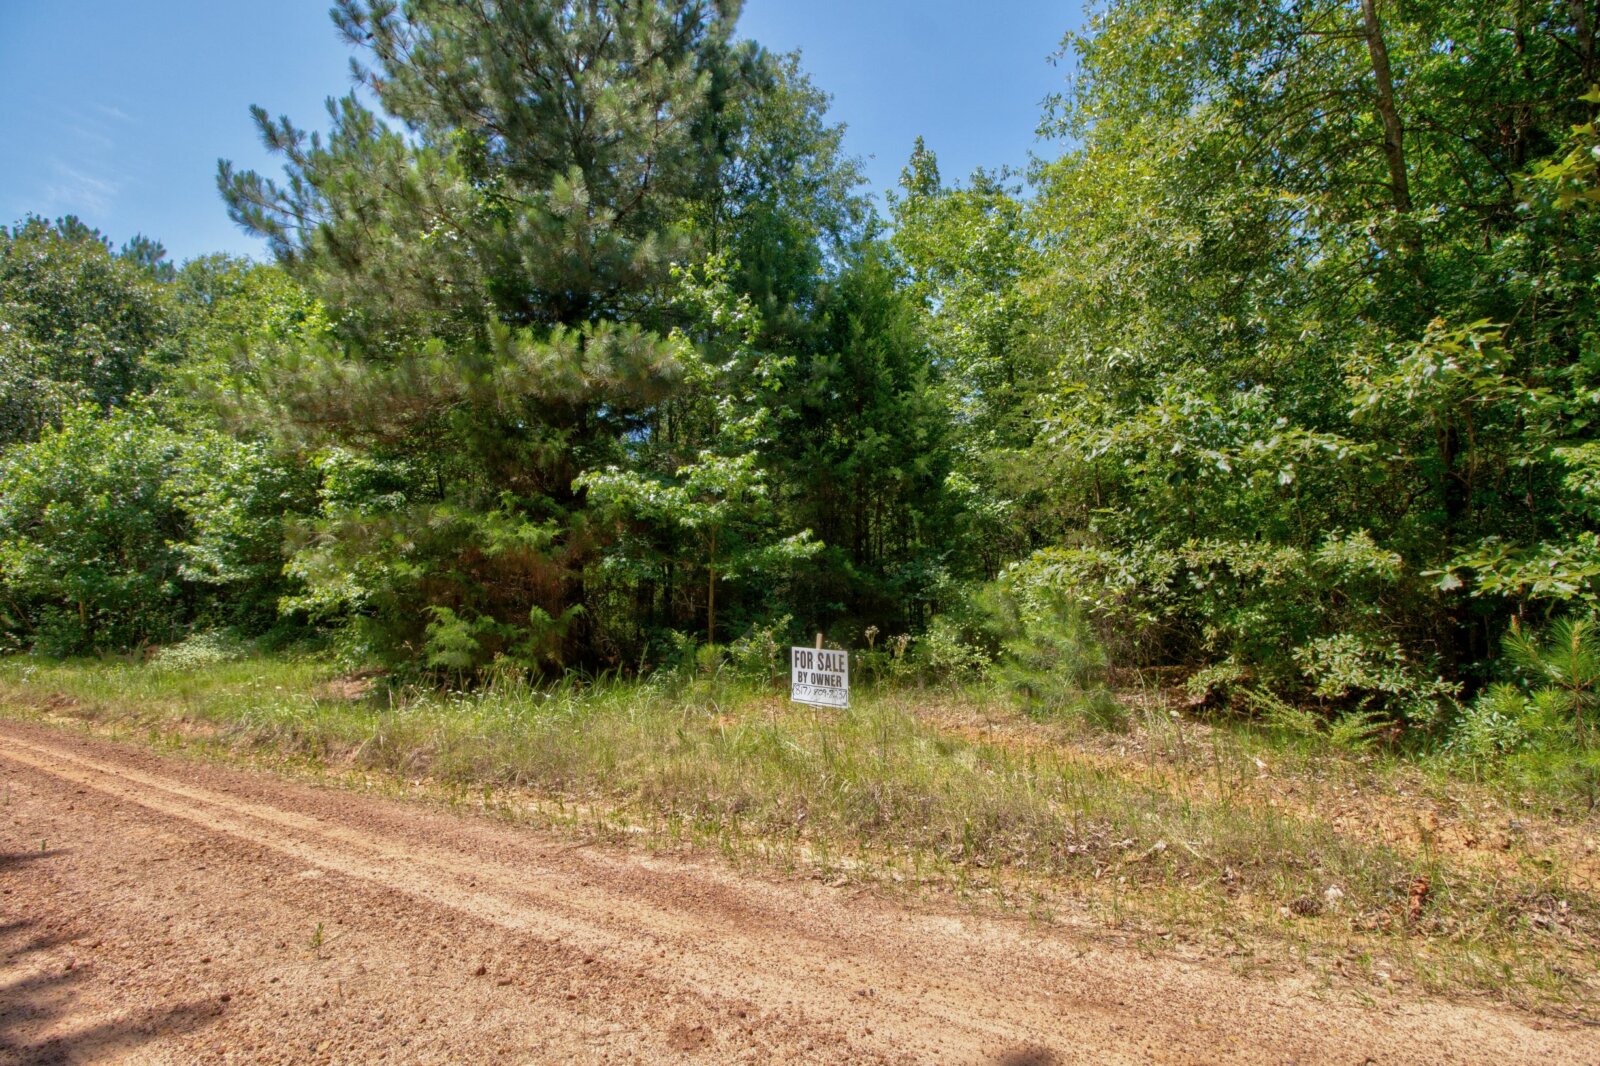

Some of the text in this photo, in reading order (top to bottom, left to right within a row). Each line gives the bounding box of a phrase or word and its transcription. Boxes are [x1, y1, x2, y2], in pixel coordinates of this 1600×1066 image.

[794, 650, 845, 673] FOR SALE
[798, 671, 842, 687] BY OWNER
